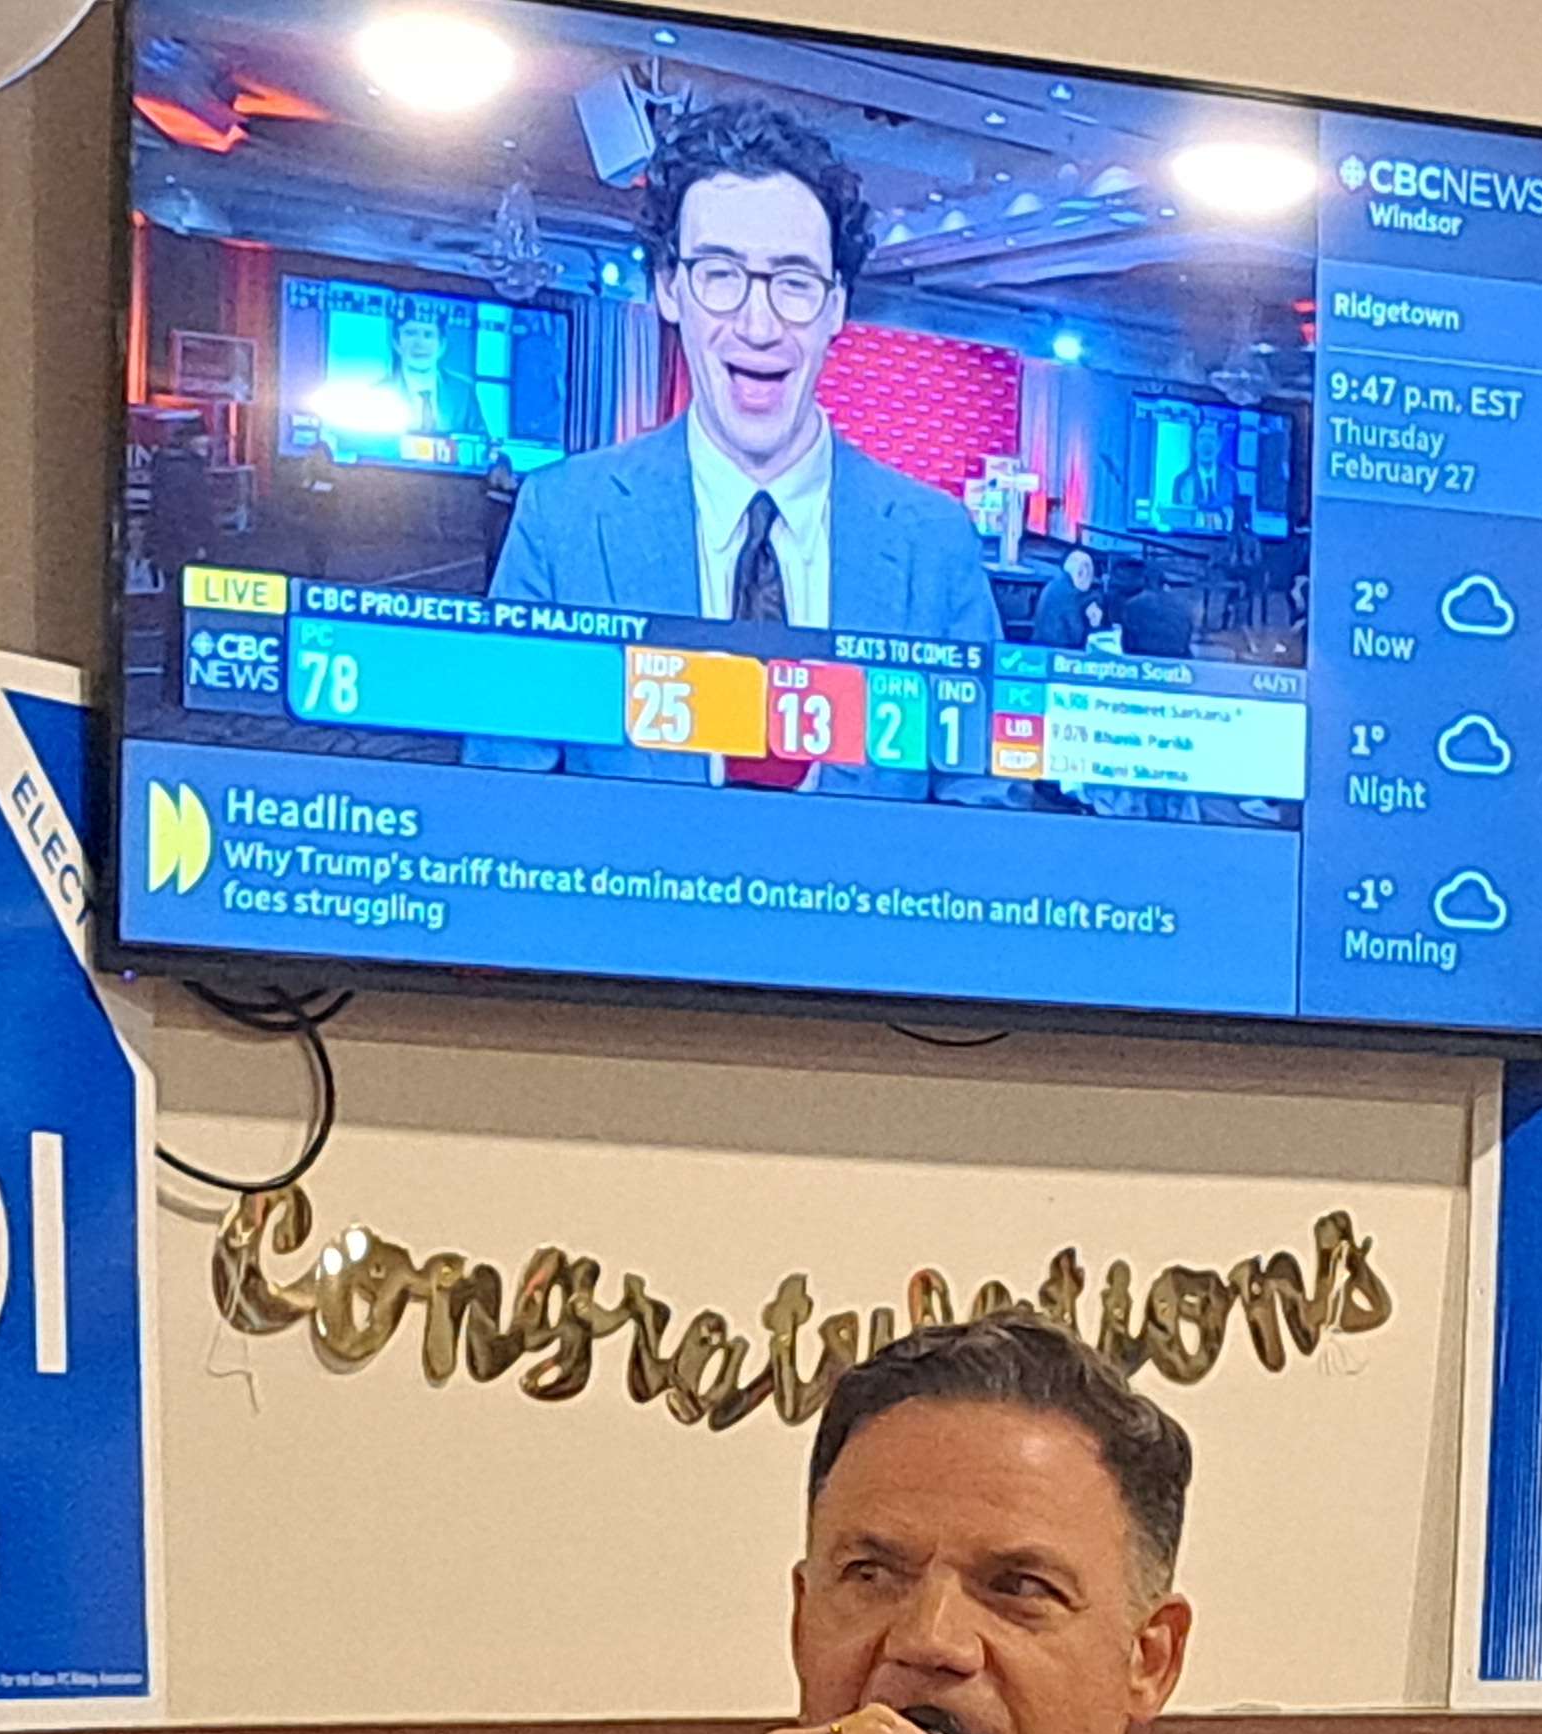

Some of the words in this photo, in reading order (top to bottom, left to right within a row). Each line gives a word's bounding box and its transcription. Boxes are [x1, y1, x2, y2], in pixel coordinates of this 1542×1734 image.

[1369, 202, 1463, 236] Windsor
[1333, 293, 1460, 331] Ridgetown
[1330, 372, 1397, 405] 9:47
[1404, 387, 1462, 415] p.m.
[1471, 388, 1523, 420] EST
[1329, 417, 1445, 458] Thursday
[1330, 452, 1440, 492] February
[1445, 464, 1476, 492] 27
[205, 575, 268, 607] LIVE
[307, 586, 356, 613] CBC
[360, 592, 490, 624] PROJECTS:
[495, 603, 527, 630] PC
[531, 606, 648, 640] MAJORITY
[217, 633, 279, 663] CBC
[300, 623, 334, 647] PC
[835, 635, 887, 661] SEATS
[888, 642, 908, 663] TO
[967, 646, 982, 669] 5
[1353, 628, 1416, 660] Now
[189, 657, 279, 692] NEWS
[299, 650, 359, 714] 78
[634, 653, 684, 677] NDP
[773, 666, 809, 689] LIB
[1053, 655, 1139, 683] Brampton
[1141, 662, 1193, 686] South
[938, 680, 976, 704] IND
[632, 679, 691, 744] 25
[777, 692, 831, 756] 13
[876, 702, 902, 760] 2
[939, 706, 960, 766] 1
[227, 787, 419, 837] Headlines
[1348, 775, 1427, 812] Night
[223, 840, 292, 877] Why
[295, 845, 414, 885] Trump's
[419, 855, 493, 887] tariff
[497, 860, 586, 893] threat
[591, 866, 743, 905] dominated
[747, 879, 870, 915] Ontario's
[875, 888, 984, 922] election
[989, 897, 1039, 926] and
[1045, 897, 1090, 929] left
[1095, 903, 1176, 934] Ford's
[223, 880, 288, 912] foes
[294, 888, 445, 930] struggling
[1345, 931, 1458, 970] Morning
